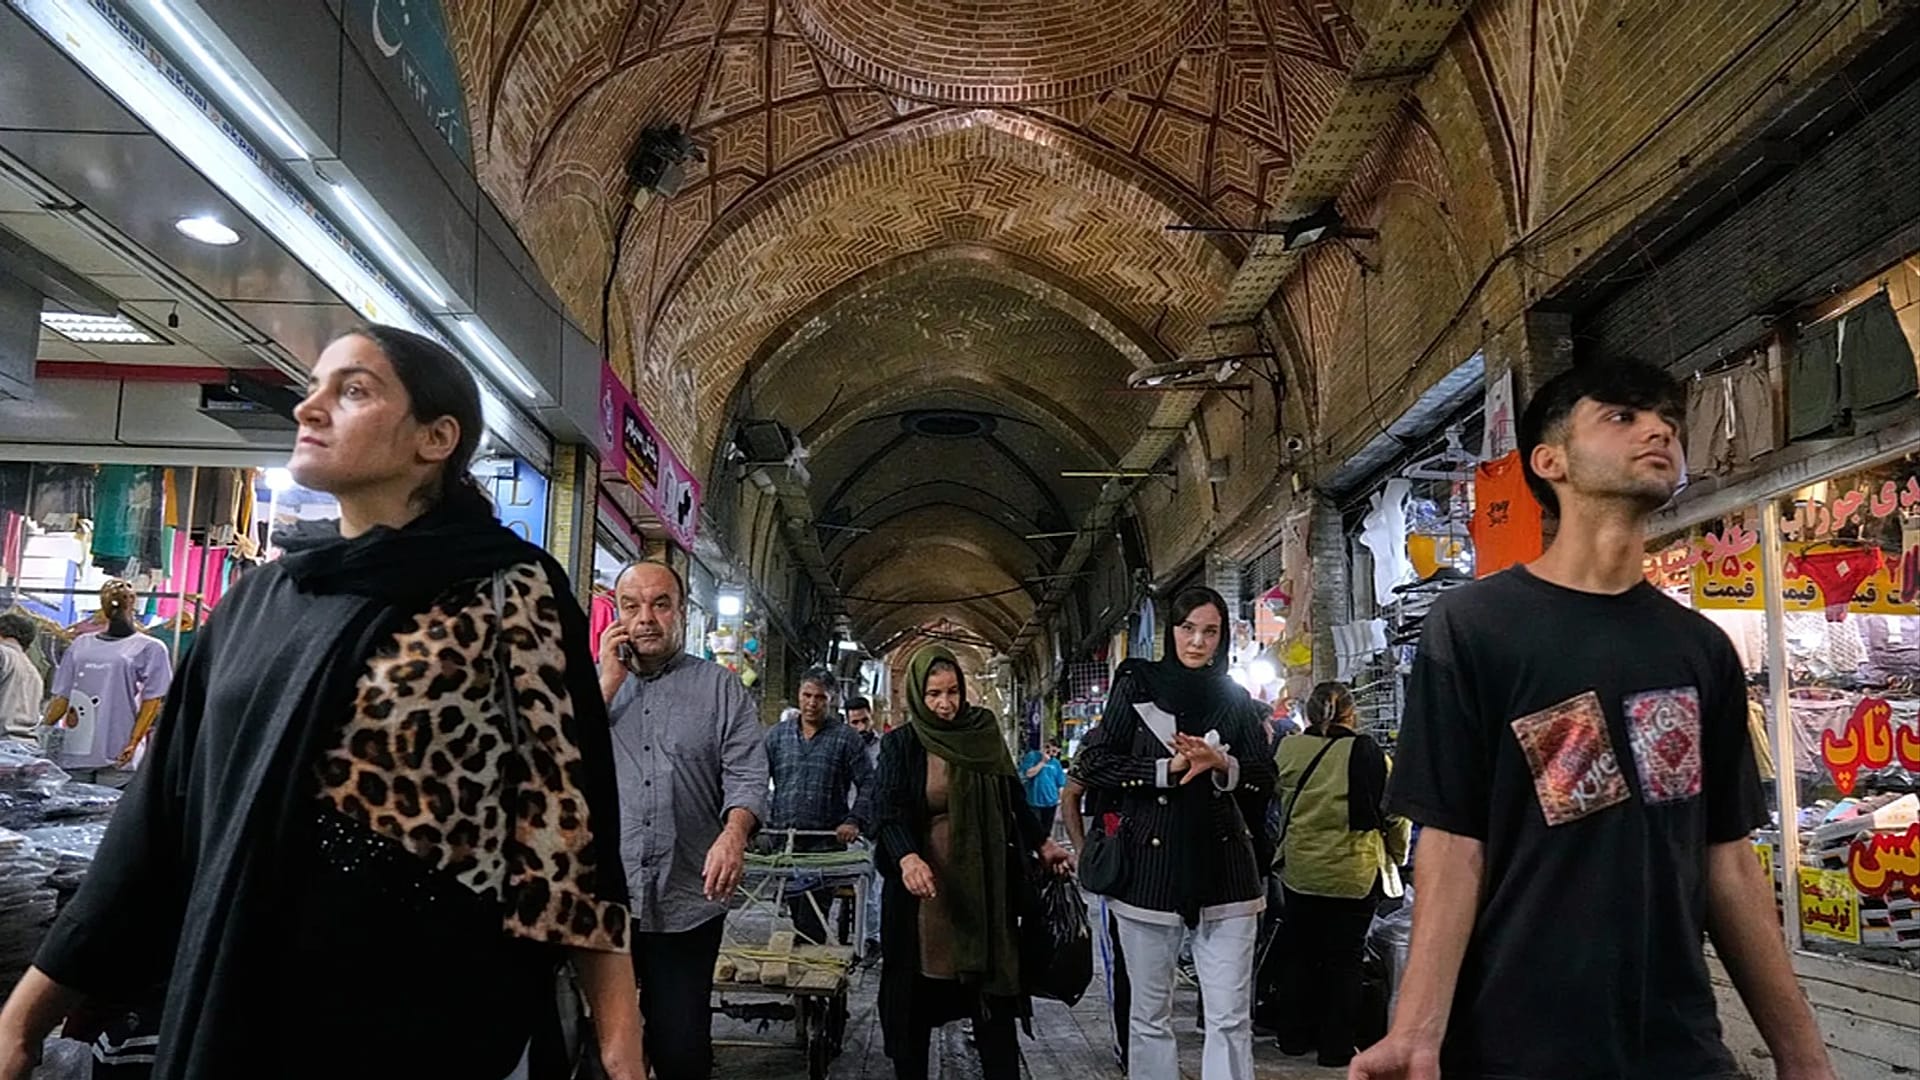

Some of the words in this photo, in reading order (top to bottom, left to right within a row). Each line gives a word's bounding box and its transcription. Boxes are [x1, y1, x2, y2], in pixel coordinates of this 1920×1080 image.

[1702, 576, 1755, 604] قیمت
[1782, 579, 1817, 606] قیم
[1823, 701, 1892, 792] تاپ
